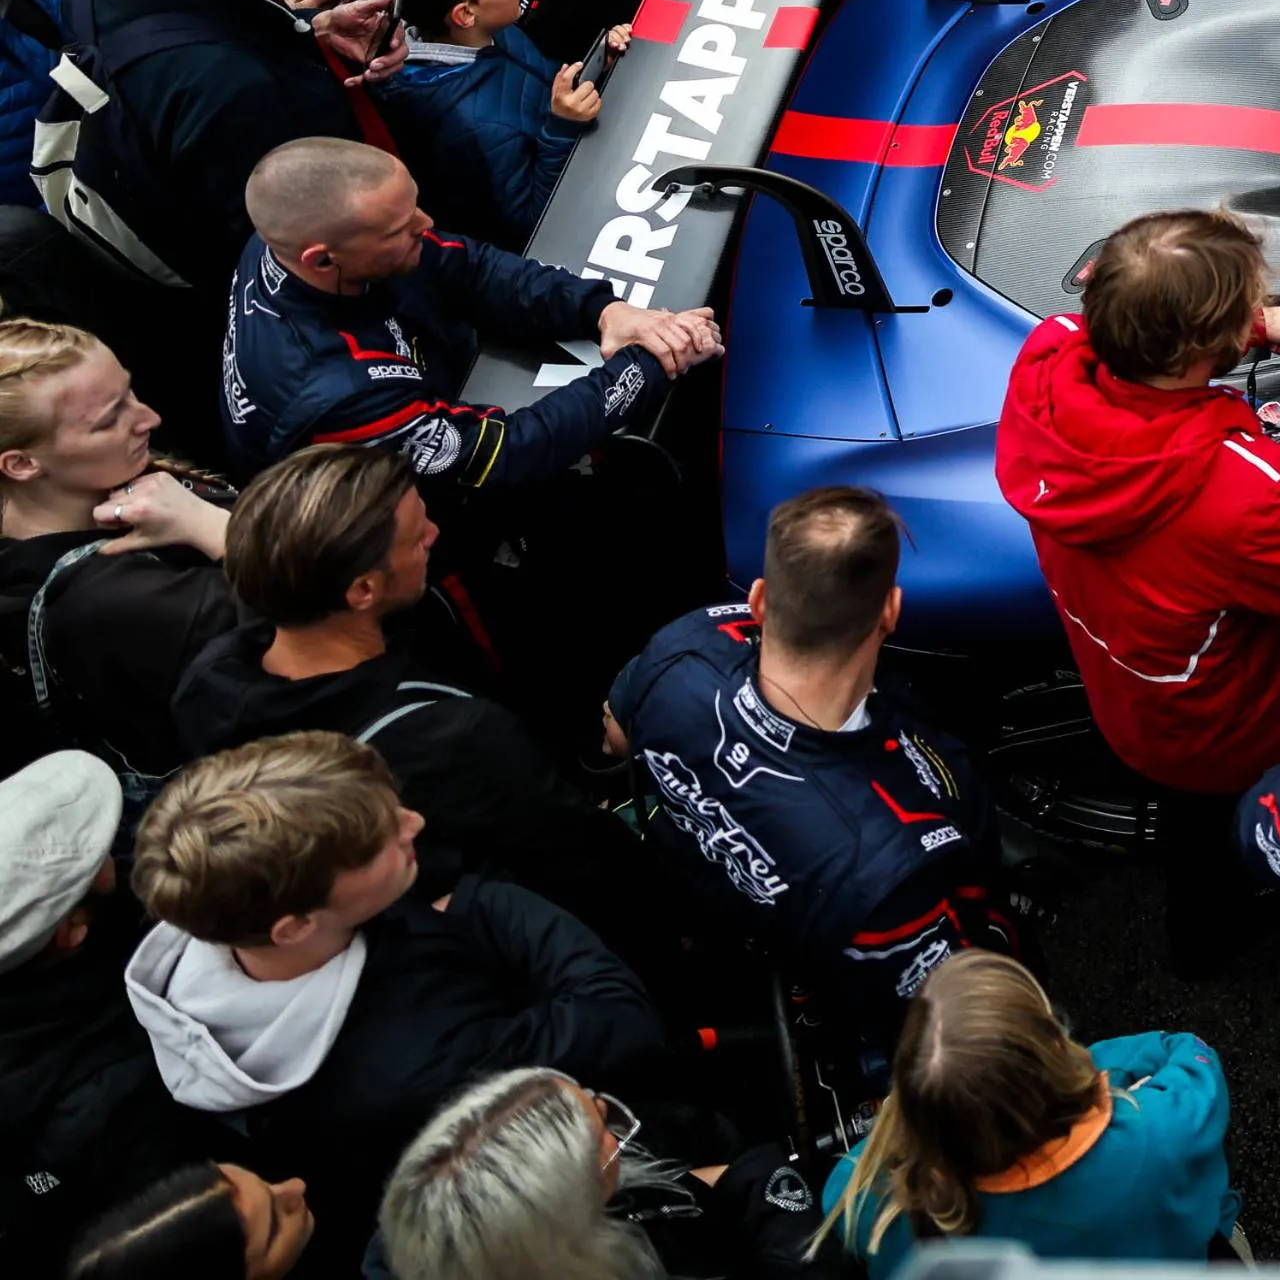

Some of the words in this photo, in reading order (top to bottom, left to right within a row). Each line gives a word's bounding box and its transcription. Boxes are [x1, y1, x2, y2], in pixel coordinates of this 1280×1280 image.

[1040, 111, 1059, 150] RACING
[1041, 81, 1080, 180] VERSTAPPEN.COM
[813, 219, 866, 297] sparco
[367, 362, 424, 381] sparco
